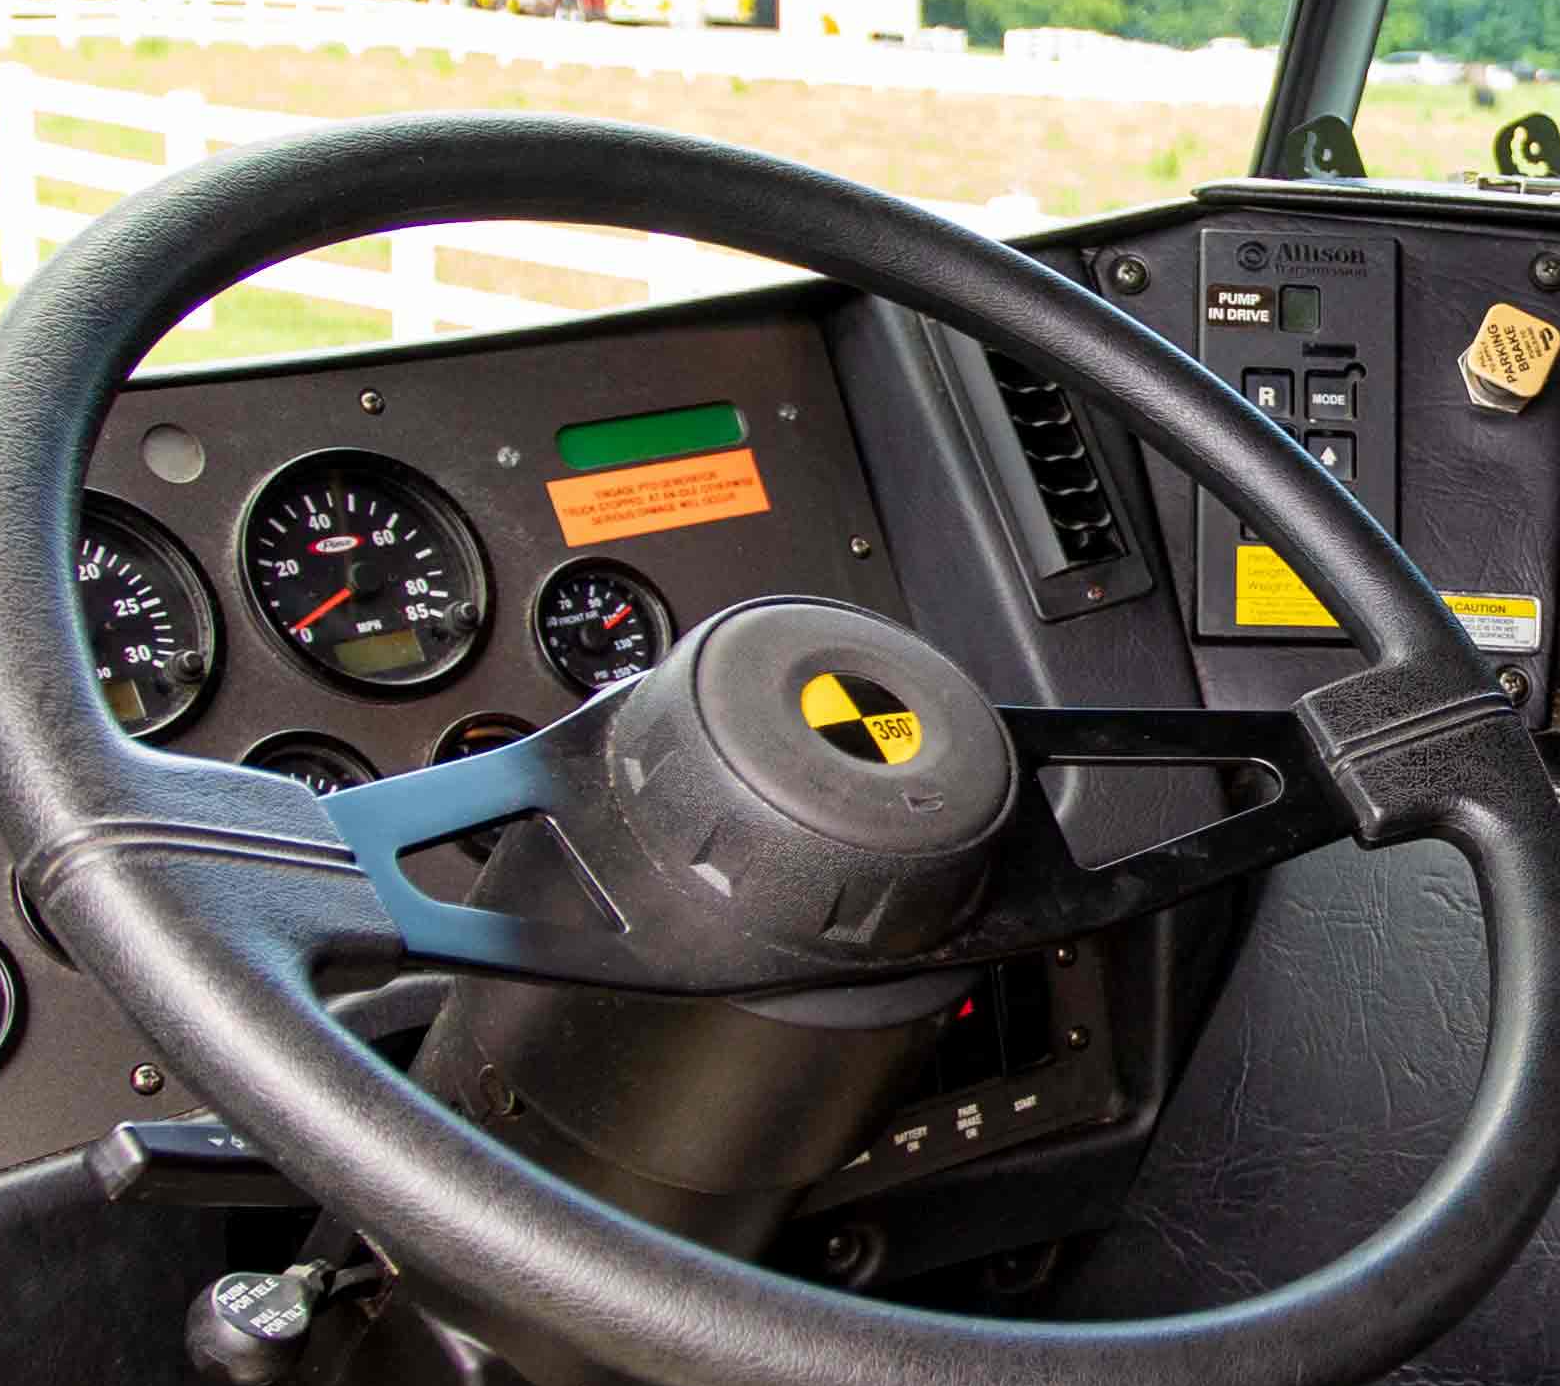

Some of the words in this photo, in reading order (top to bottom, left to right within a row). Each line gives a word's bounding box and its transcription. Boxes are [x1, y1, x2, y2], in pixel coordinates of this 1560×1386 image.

[1272, 243, 1366, 264] Allison
[1218, 293, 1261, 306] PUMP
[1208, 308, 1224, 320] IN
[1227, 308, 1270, 322] DRIVE
[1488, 324, 1517, 383] PARKING
[1504, 325, 1530, 372] BRAKE
[1258, 387, 1275, 407] R
[1312, 393, 1346, 405] MODE
[308, 513, 331, 531] 40
[371, 529, 395, 546] 60
[77, 562, 100, 581] 20
[275, 559, 299, 577] 20
[405, 578, 428, 595] 80
[113, 598, 140, 616] 25
[405, 603, 428, 621] 85
[1455, 603, 1506, 613] CAUTION
[355, 619, 383, 633] MPH
[300, 628, 313, 643] 0
[123, 644, 151, 663] 30
[894, 1125, 928, 1146] BATTERY
[217, 1281, 248, 1305] PUSH
[228, 1295, 255, 1313] FOR
[248, 1277, 279, 1299] TELE
[249, 1308, 280, 1328] PULL
[261, 1318, 289, 1336] FOR
[281, 1303, 307, 1322] TILT
